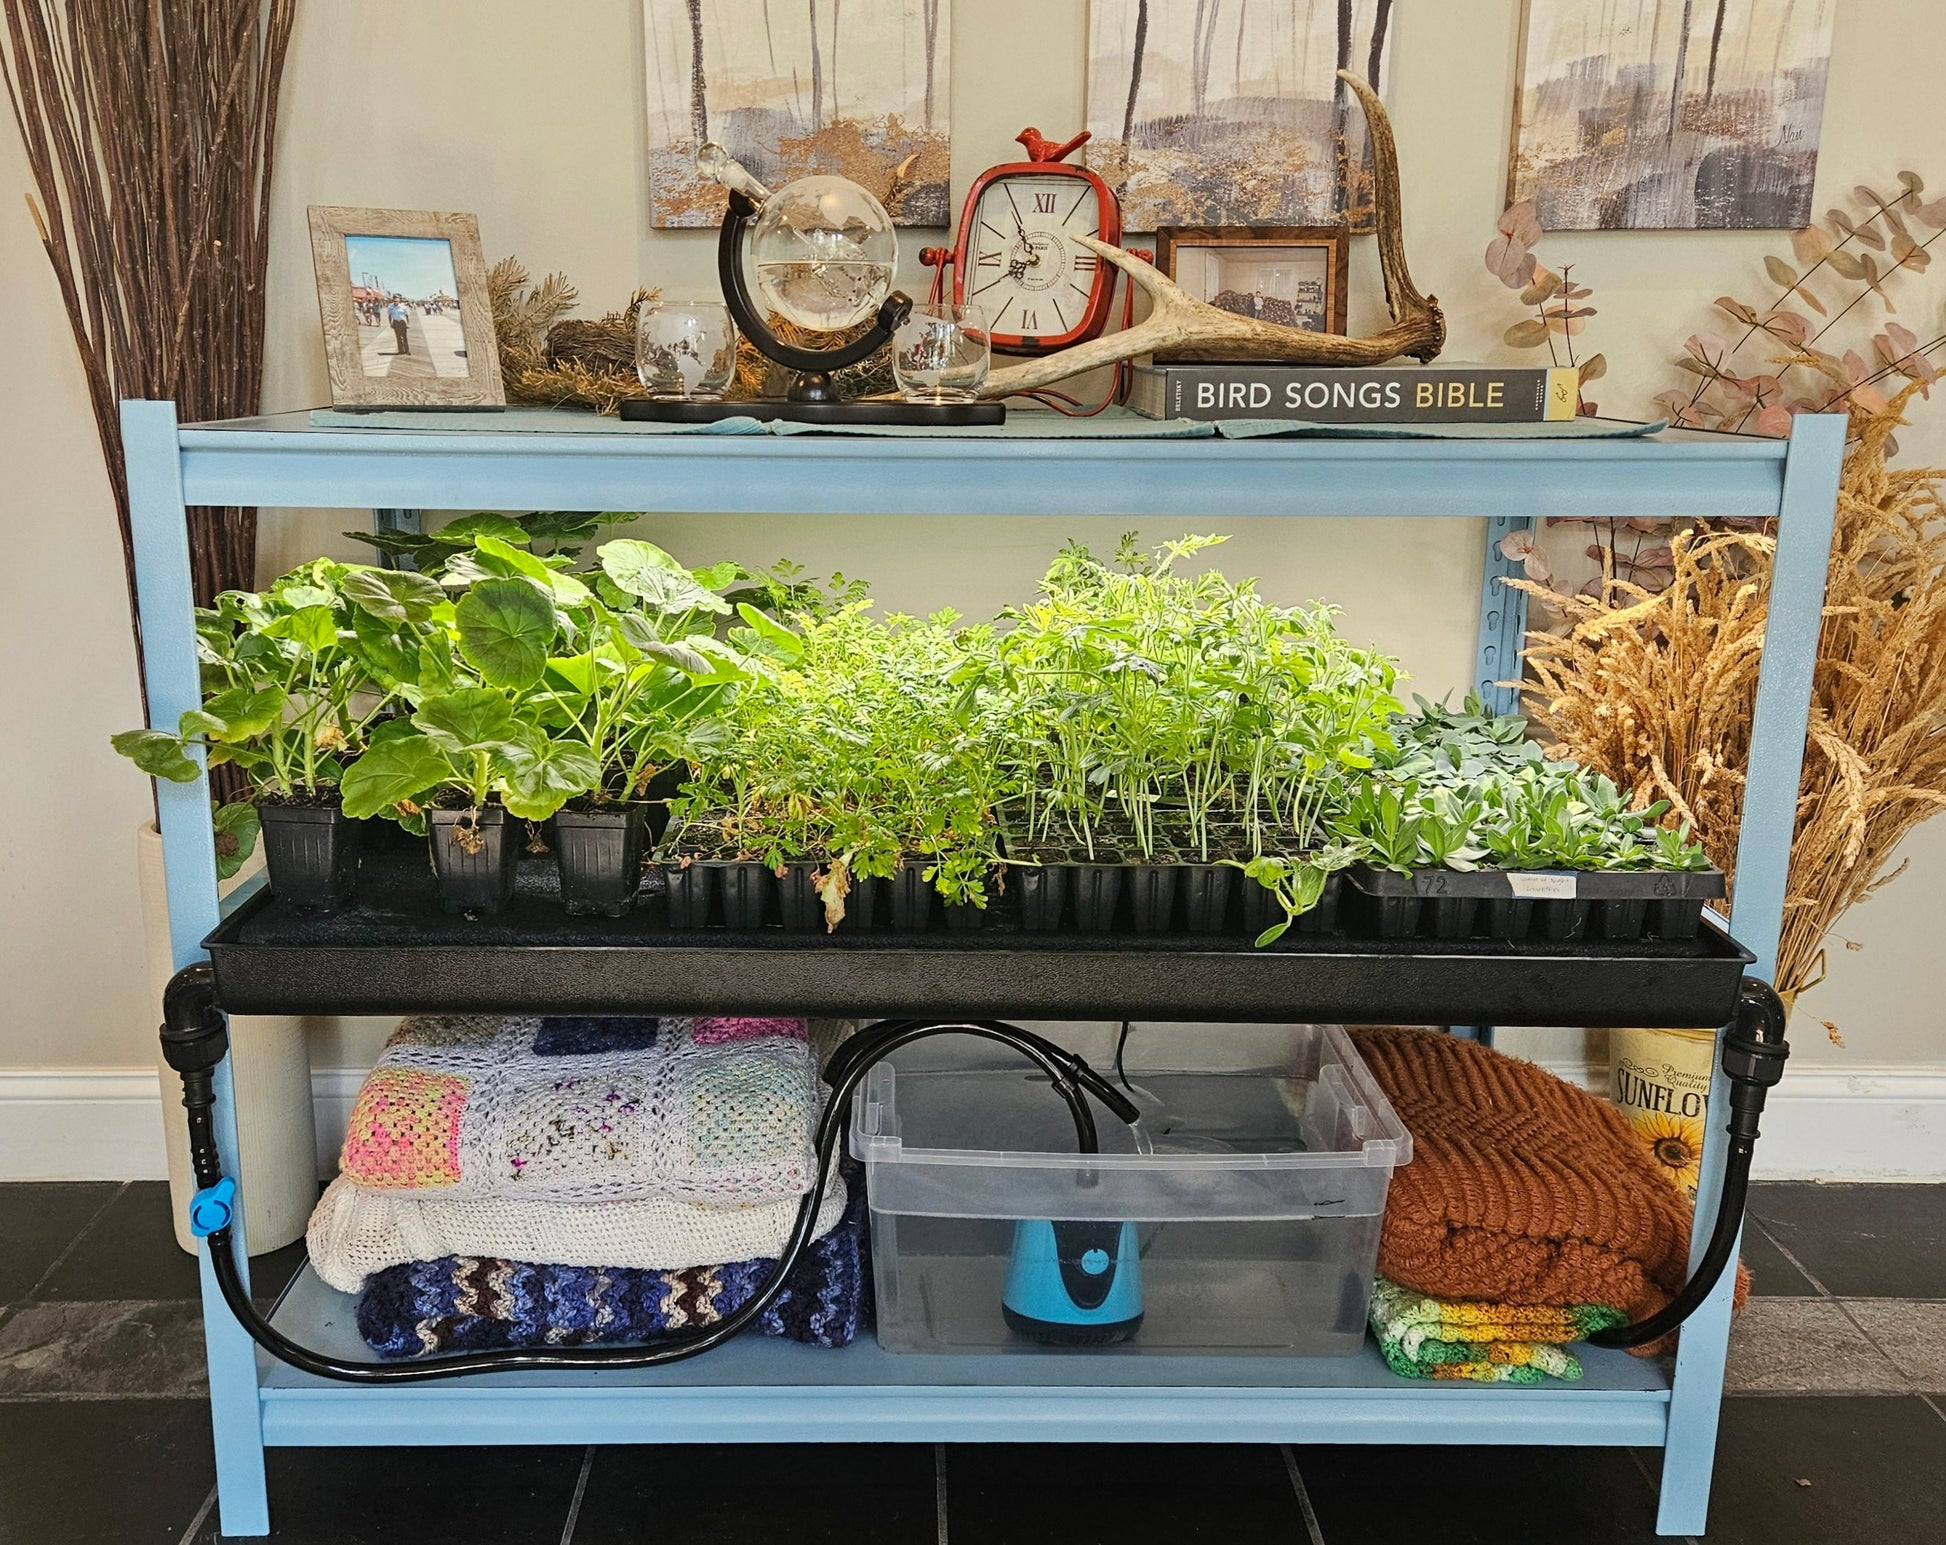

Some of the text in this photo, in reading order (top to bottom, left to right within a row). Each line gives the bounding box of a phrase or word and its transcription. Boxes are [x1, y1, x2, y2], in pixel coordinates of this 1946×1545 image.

[1032, 193, 1057, 213] XII
[978, 250, 1002, 267] IX
[1074, 254, 1097, 271] III
[1020, 309, 1038, 330] VI
[1197, 382, 1272, 409] BIRD
[1285, 381, 1401, 409] SONGS
[1416, 382, 1505, 408] BIBLE
[1423, 875, 1448, 894] 72
[1664, 1074, 1707, 1093] Quality
